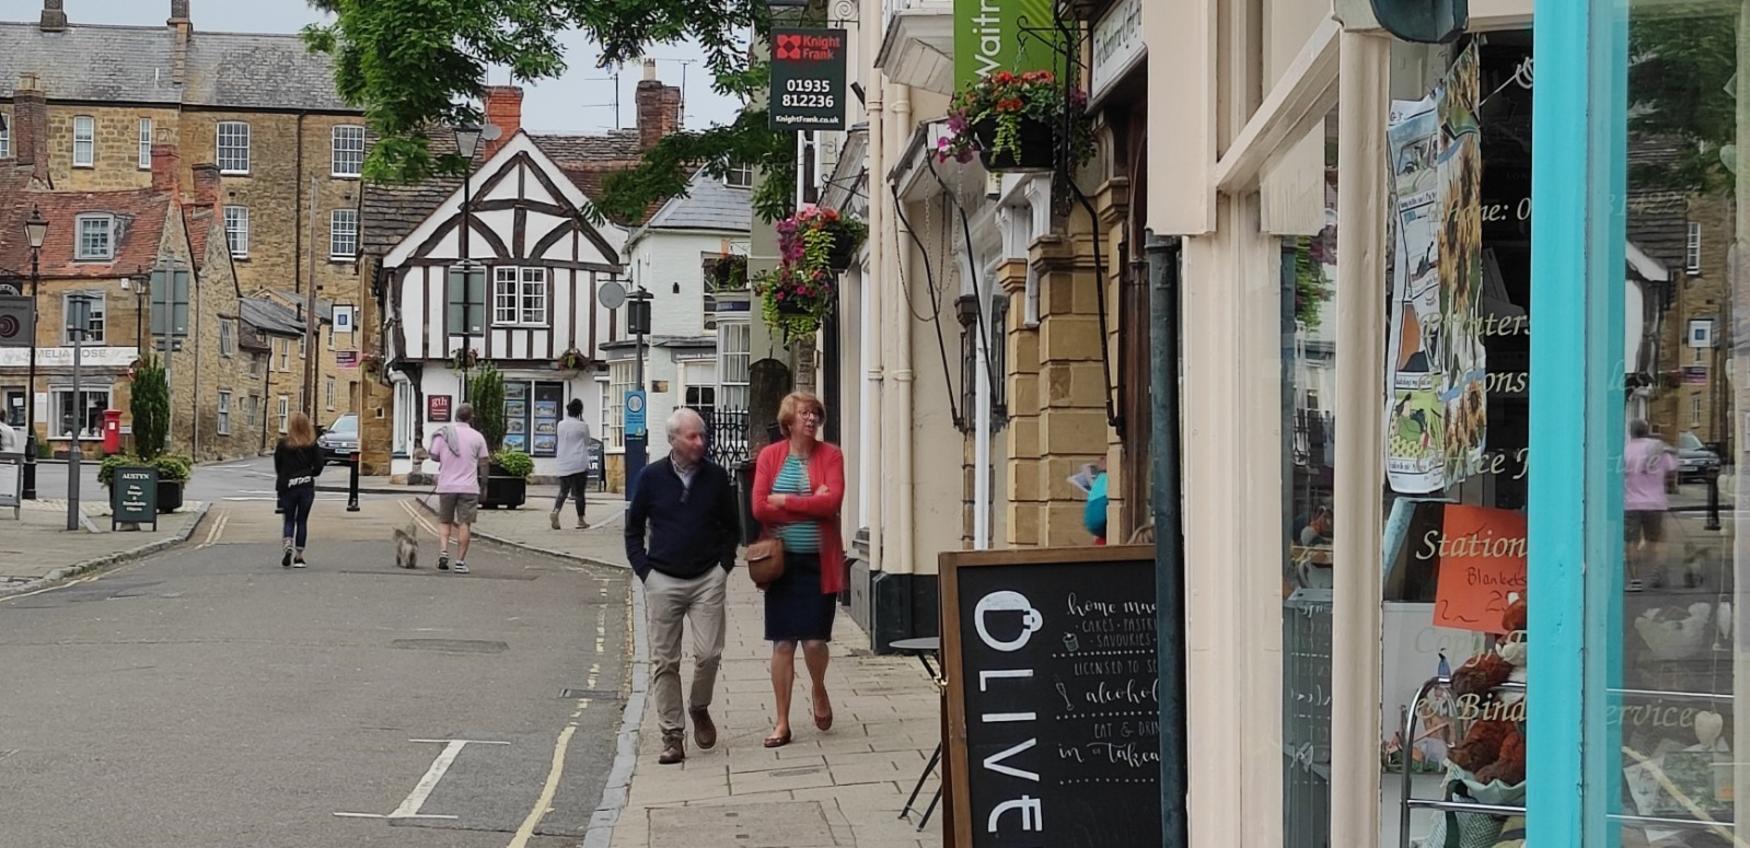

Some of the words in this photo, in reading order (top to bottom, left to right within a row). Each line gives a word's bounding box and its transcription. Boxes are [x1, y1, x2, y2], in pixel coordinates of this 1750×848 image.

[802, 35, 840, 49] Knight
[802, 48, 834, 59] Frank
[786, 79, 830, 92] 01935
[782, 94, 834, 108] 812236
[775, 115, 839, 124] KnightFrank.co.uk
[80, 349, 106, 359] OSE
[1067, 592, 1116, 617] home
[1082, 618, 1114, 633] CAKES
[1096, 632, 1151, 648] SAVOURIES
[1074, 660, 1123, 676] LICENSED
[1127, 660, 1140, 674] TO
[1086, 679, 1159, 704] alcohol
[974, 590, 1043, 833] OLIVE
[1094, 722, 1112, 739] EAT
[1120, 721, 1134, 738] &
[1058, 743, 1084, 763] in
